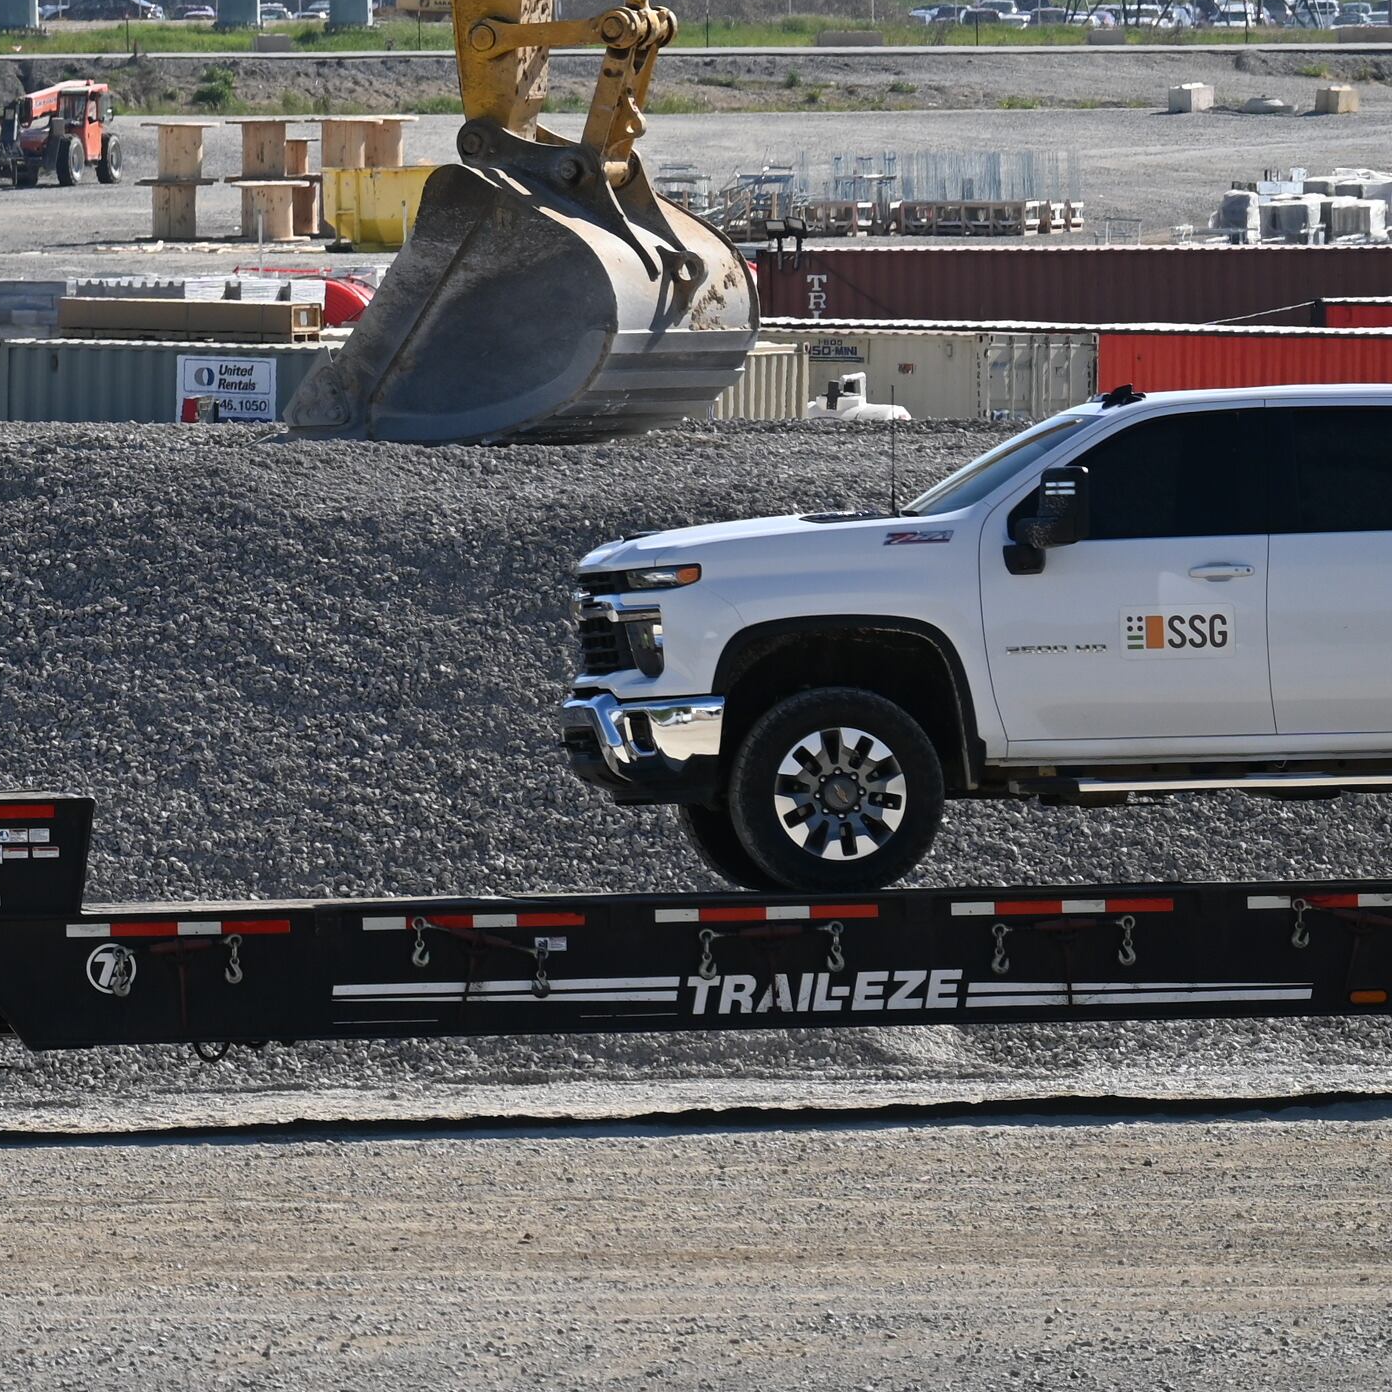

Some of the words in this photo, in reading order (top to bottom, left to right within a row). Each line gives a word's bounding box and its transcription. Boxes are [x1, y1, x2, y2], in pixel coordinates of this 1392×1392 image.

[219, 364, 254, 376] United
[218, 378, 256, 391] Rentals
[1168, 613, 1228, 649] SSG
[687, 969, 963, 1015] TRAIL-EZE
